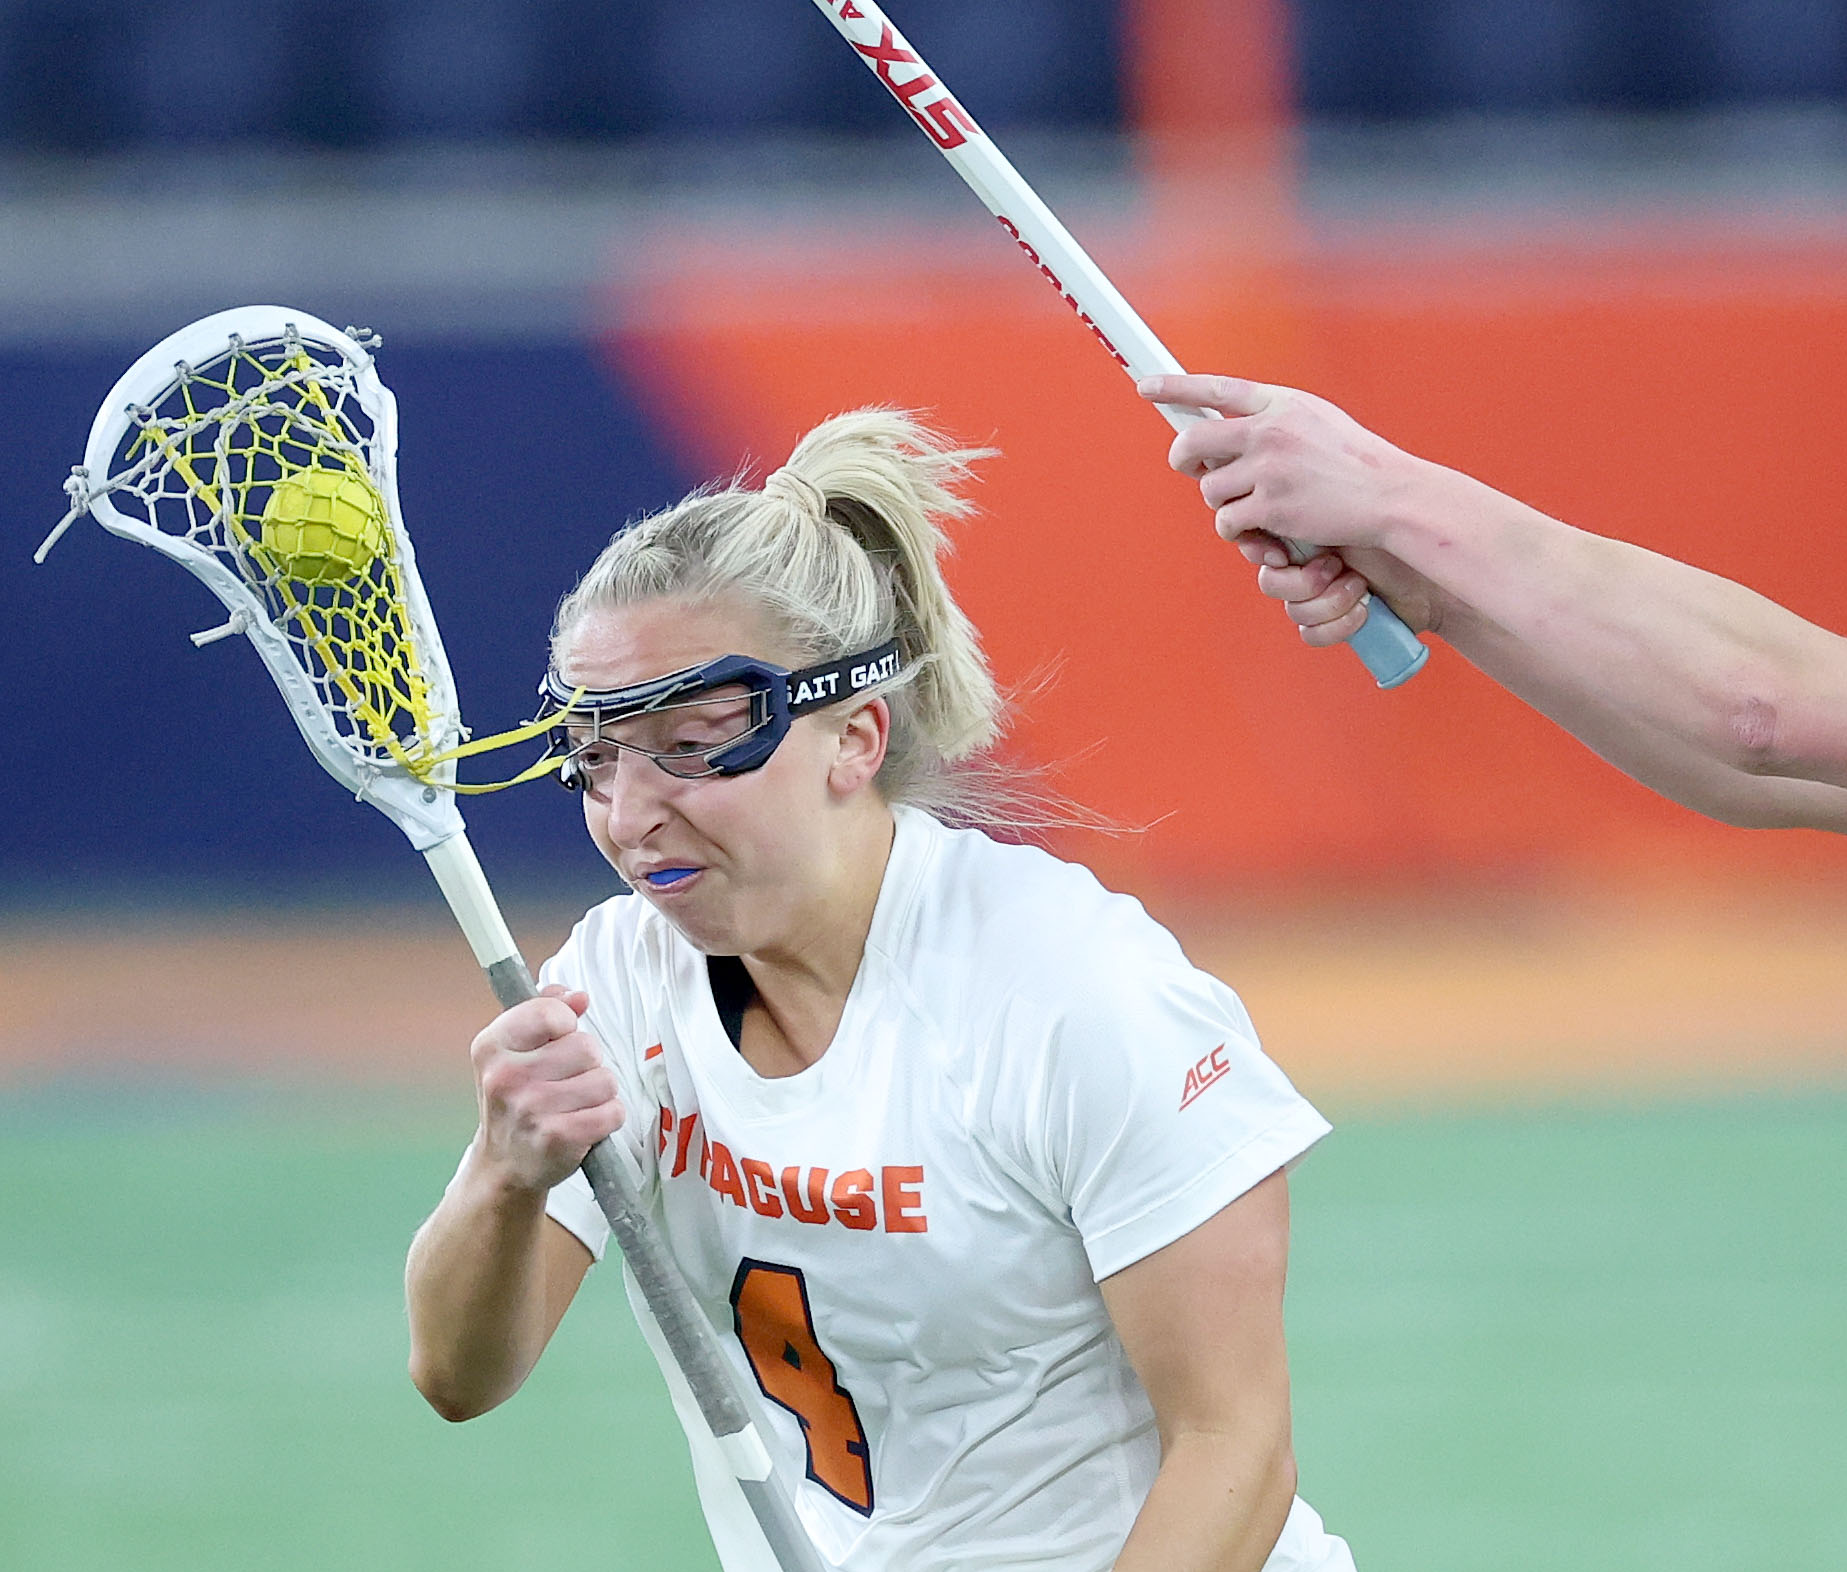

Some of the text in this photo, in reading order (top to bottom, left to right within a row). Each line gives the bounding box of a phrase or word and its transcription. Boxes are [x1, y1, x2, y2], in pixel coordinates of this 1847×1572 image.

[849, 20, 981, 150] STX
[850, 653, 894, 689] GAIT
[1181, 1042, 1229, 1103] ACC
[729, 1256, 874, 1519] 4
